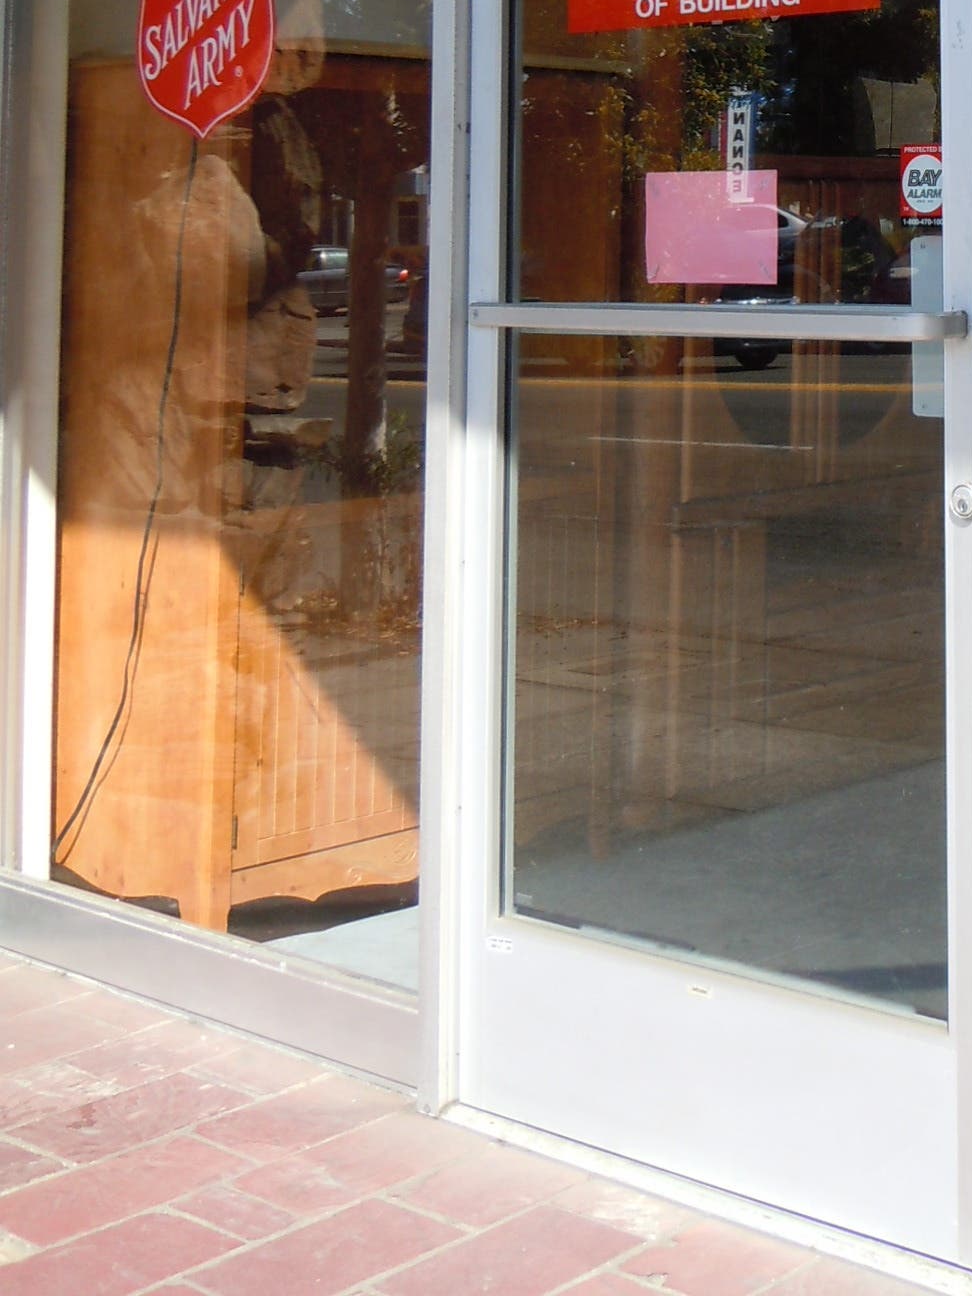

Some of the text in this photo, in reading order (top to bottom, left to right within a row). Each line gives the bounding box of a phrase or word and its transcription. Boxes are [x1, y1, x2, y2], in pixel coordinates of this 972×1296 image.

[904, 146, 937, 154] PROTECTED
[908, 169, 942, 187] BAY
[907, 189, 942, 199] ALARM
